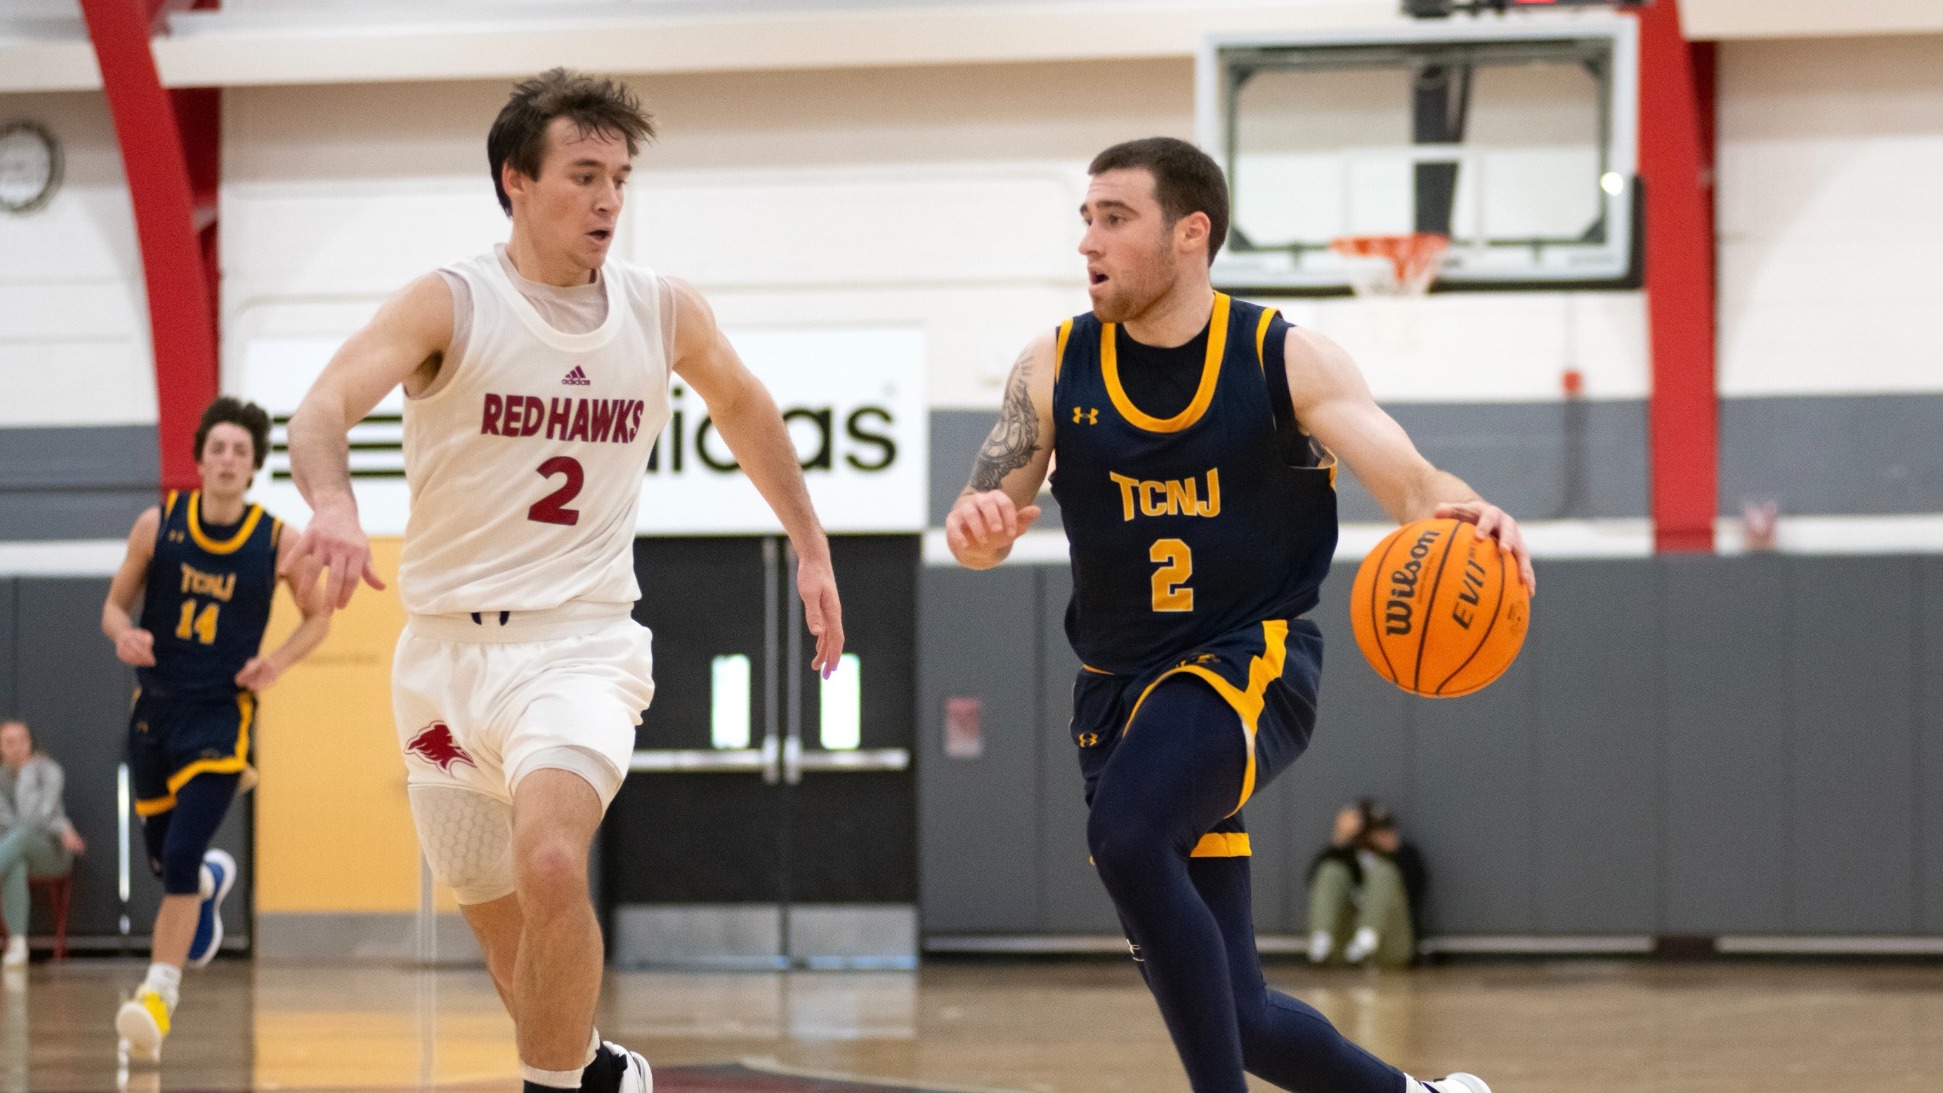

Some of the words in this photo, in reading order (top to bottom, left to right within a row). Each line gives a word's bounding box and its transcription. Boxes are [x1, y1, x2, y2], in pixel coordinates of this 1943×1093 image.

[561, 376, 591, 386] adidas
[646, 386, 898, 471] ias
[527, 456, 585, 526] 2
[1109, 467, 1221, 522] TCNJ
[180, 561, 237, 602] TCNJ
[1150, 538, 1194, 612] 2
[1386, 529, 1441, 637] Wilson
[175, 598, 220, 645] 14
